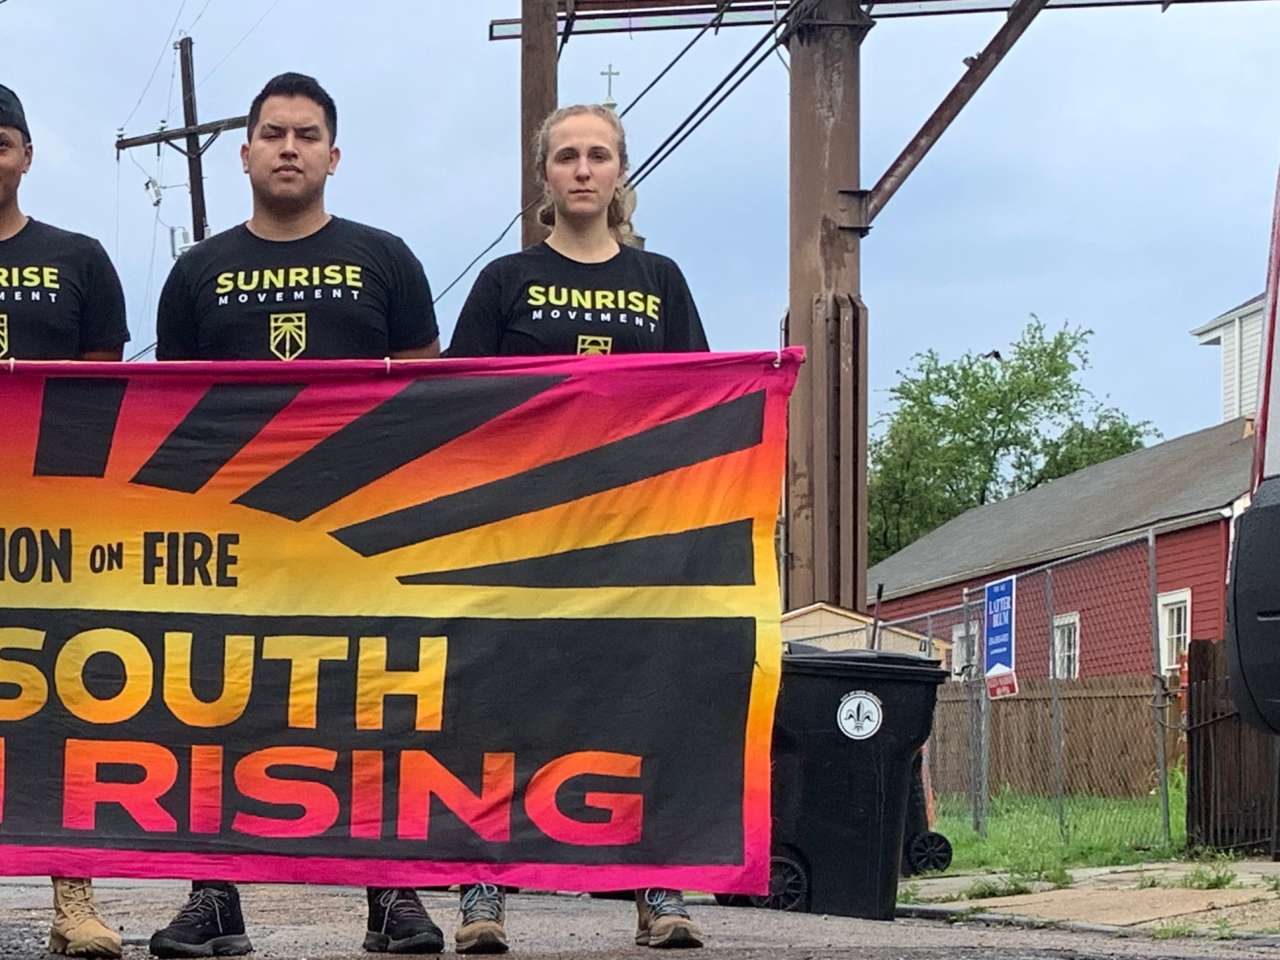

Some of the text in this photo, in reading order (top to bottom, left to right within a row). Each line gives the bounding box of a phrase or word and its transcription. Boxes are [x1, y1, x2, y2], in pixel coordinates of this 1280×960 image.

[215, 265, 363, 294] SUNRISE
[218, 288, 360, 306] MOVEMENT
[527, 285, 661, 321] SUNRISE
[532, 309, 657, 332] MOVEMENT
[89, 541, 123, 573] ON
[143, 531, 240, 587] FIRE
[62, 738, 644, 846] RISING
